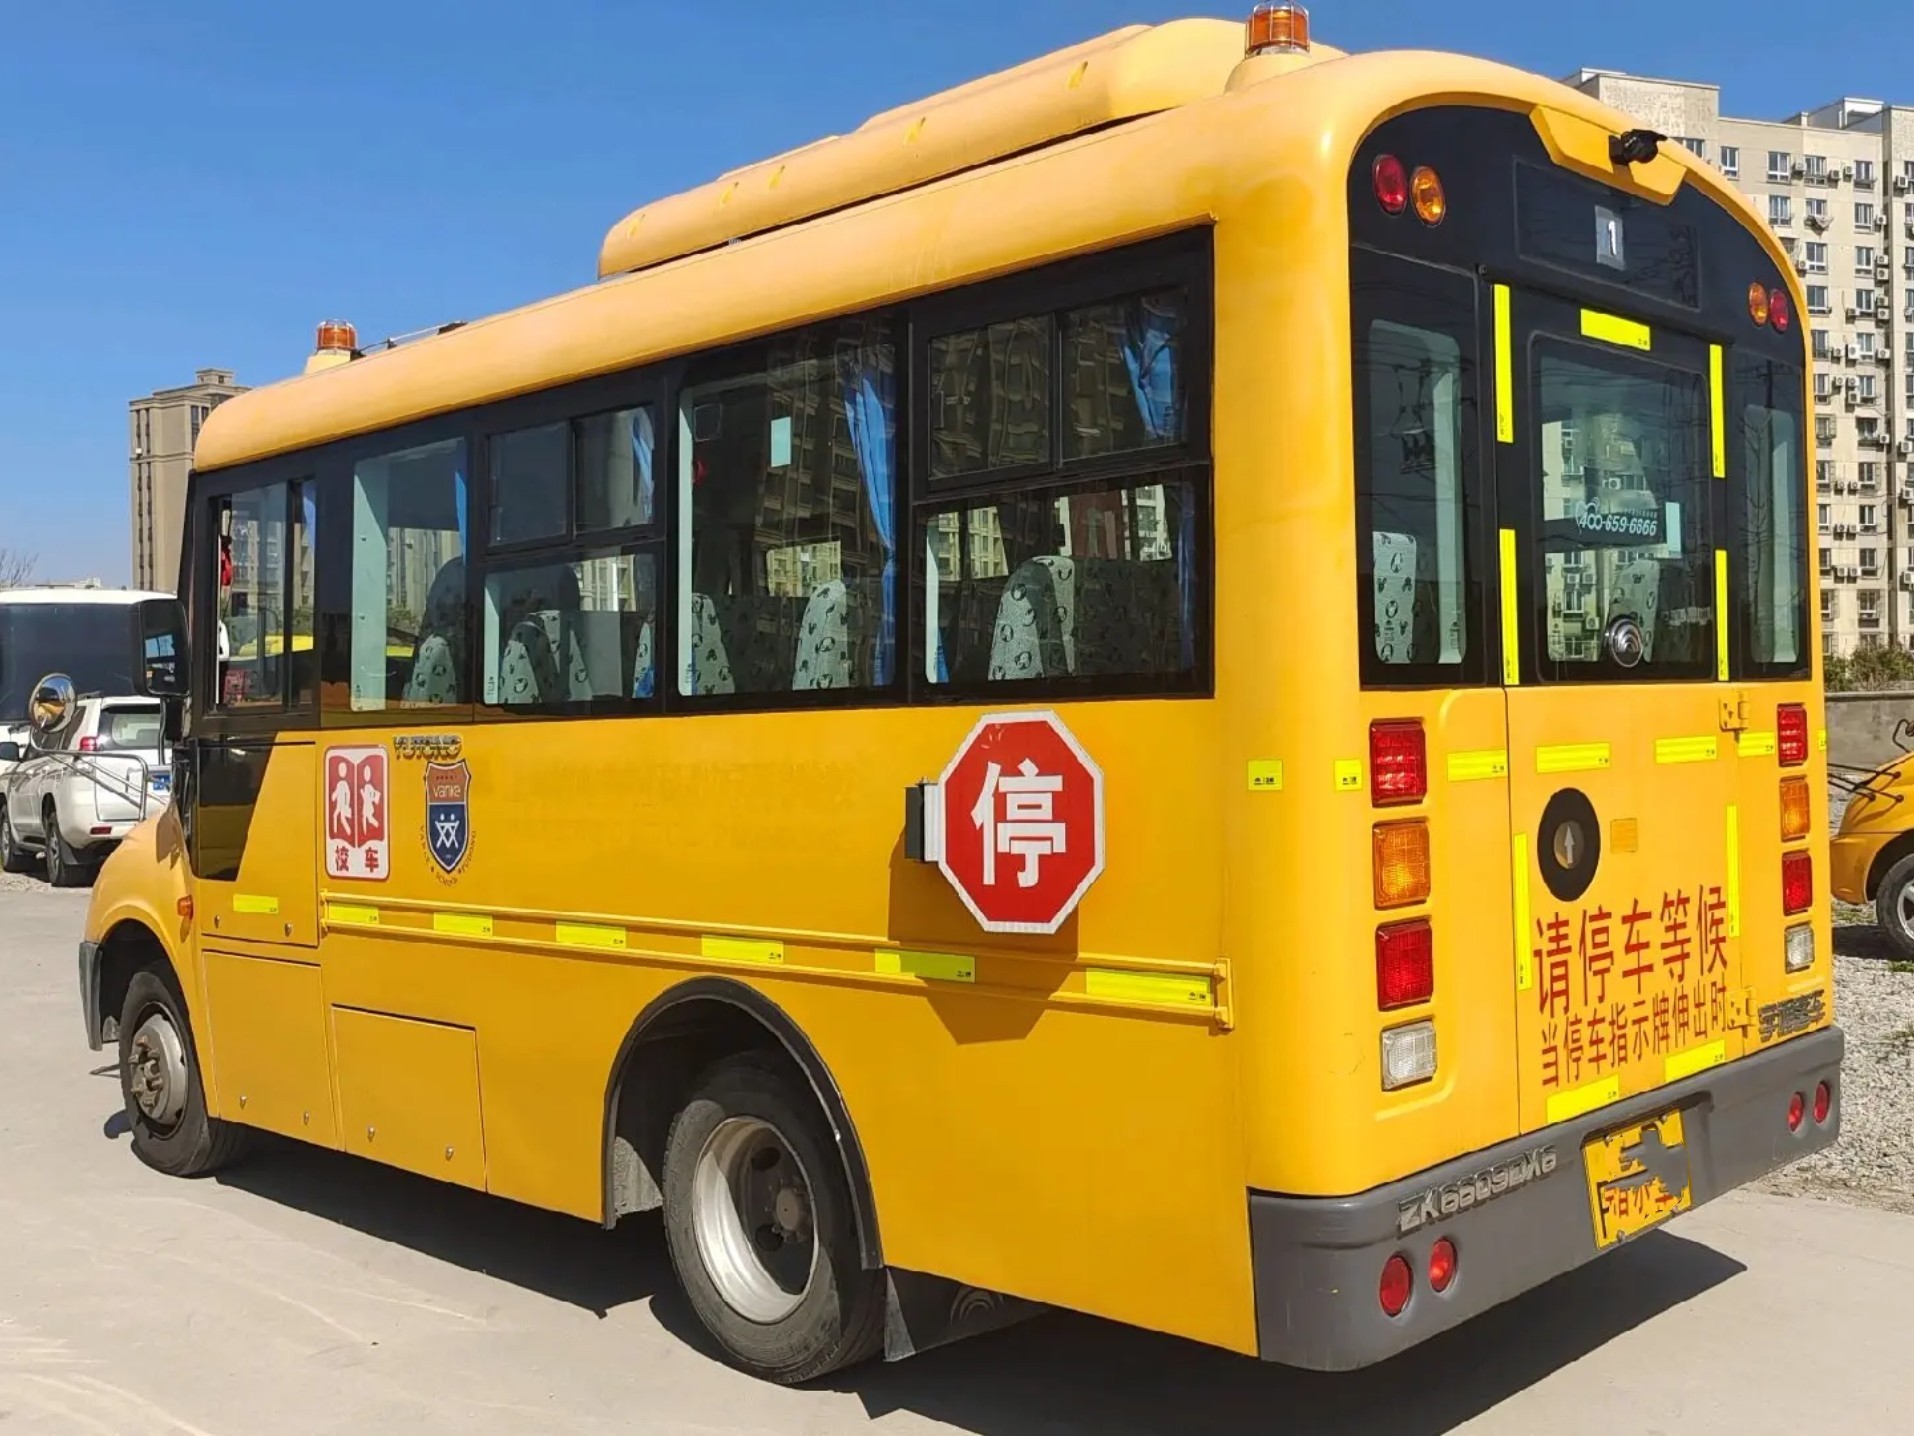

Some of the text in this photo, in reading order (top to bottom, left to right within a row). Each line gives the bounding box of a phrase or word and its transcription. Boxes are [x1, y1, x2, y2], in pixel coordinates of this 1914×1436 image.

[1607, 219, 1617, 256] 1
[970, 758, 1067, 888] 停
[1533, 884, 1728, 1018] 请停车等候
[1541, 971, 1727, 1087] 当停车指示牌伸出时
